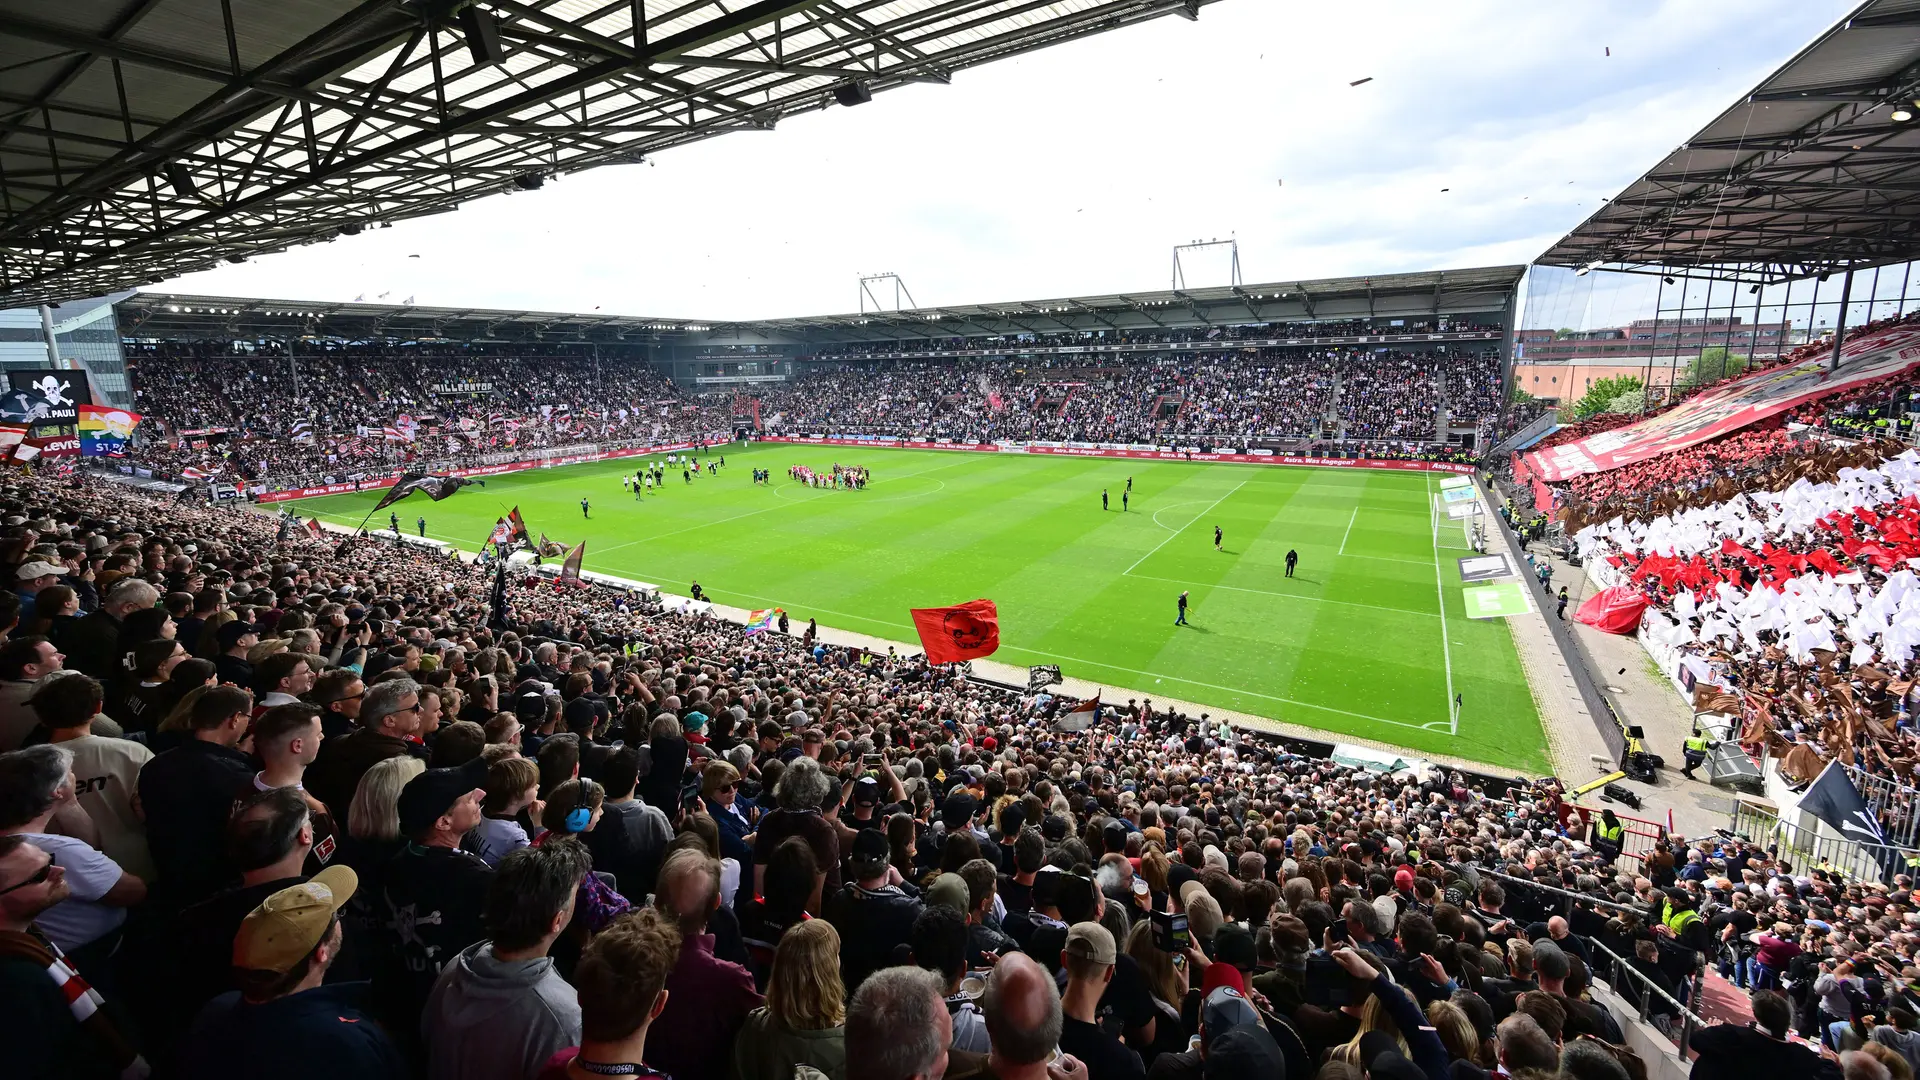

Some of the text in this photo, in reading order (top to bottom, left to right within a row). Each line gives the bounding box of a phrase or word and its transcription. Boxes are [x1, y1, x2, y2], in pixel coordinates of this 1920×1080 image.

[52, 409, 75, 418] PAULI
[96, 443, 112, 452] ST.
[346, 481, 382, 490] daegen?
